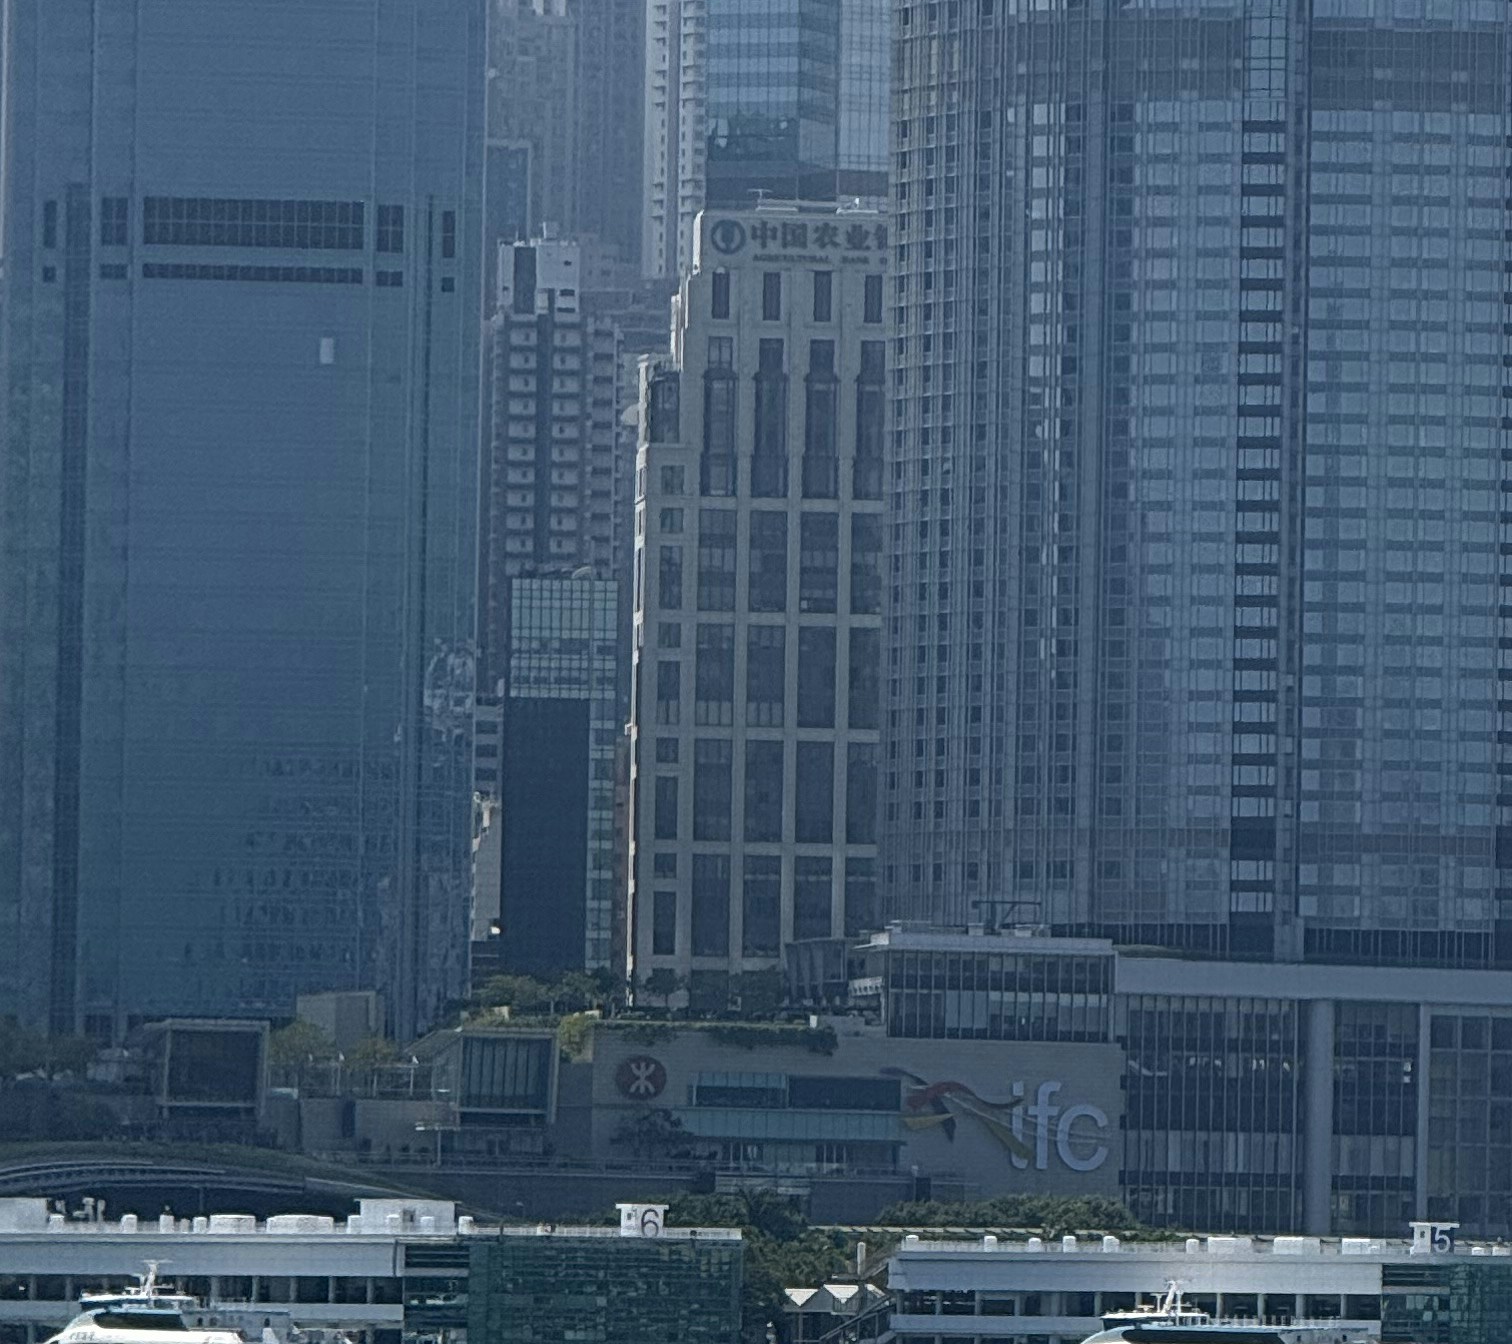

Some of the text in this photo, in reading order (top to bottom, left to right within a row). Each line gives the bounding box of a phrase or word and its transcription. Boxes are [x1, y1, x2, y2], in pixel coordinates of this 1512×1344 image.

[1011, 1080, 1109, 1172] ifc
[641, 1208, 660, 1238] 6
[1433, 1225, 1451, 1254] 5
